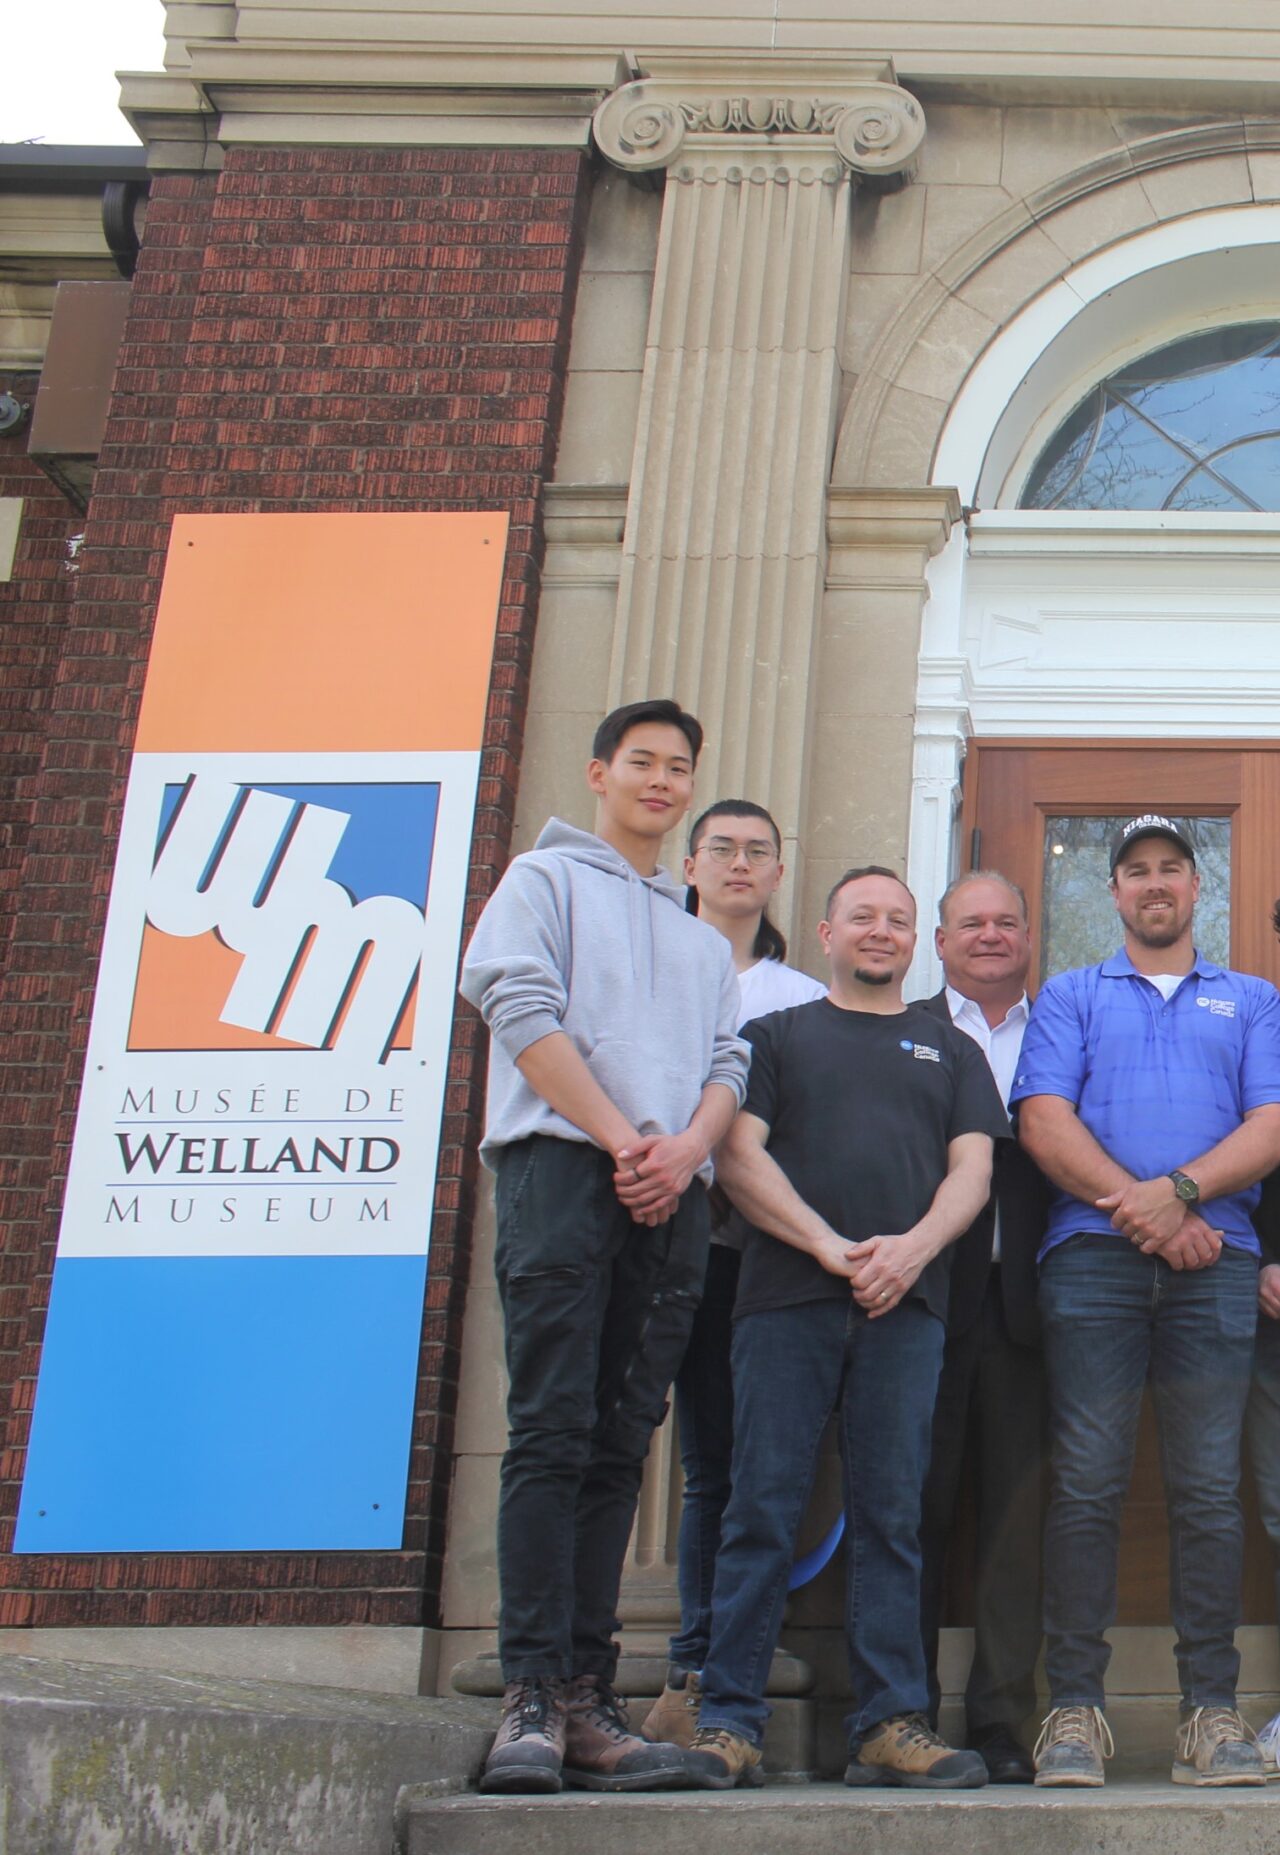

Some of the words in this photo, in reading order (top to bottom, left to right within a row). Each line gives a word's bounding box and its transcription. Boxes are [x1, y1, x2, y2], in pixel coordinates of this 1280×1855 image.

[1123, 814, 1178, 838] NIAGARA
[120, 1084, 300, 1114] MUSÉE
[344, 1088, 404, 1113] DE
[114, 1132, 401, 1174] WELLAND
[104, 1195, 392, 1223] MUSEUM
